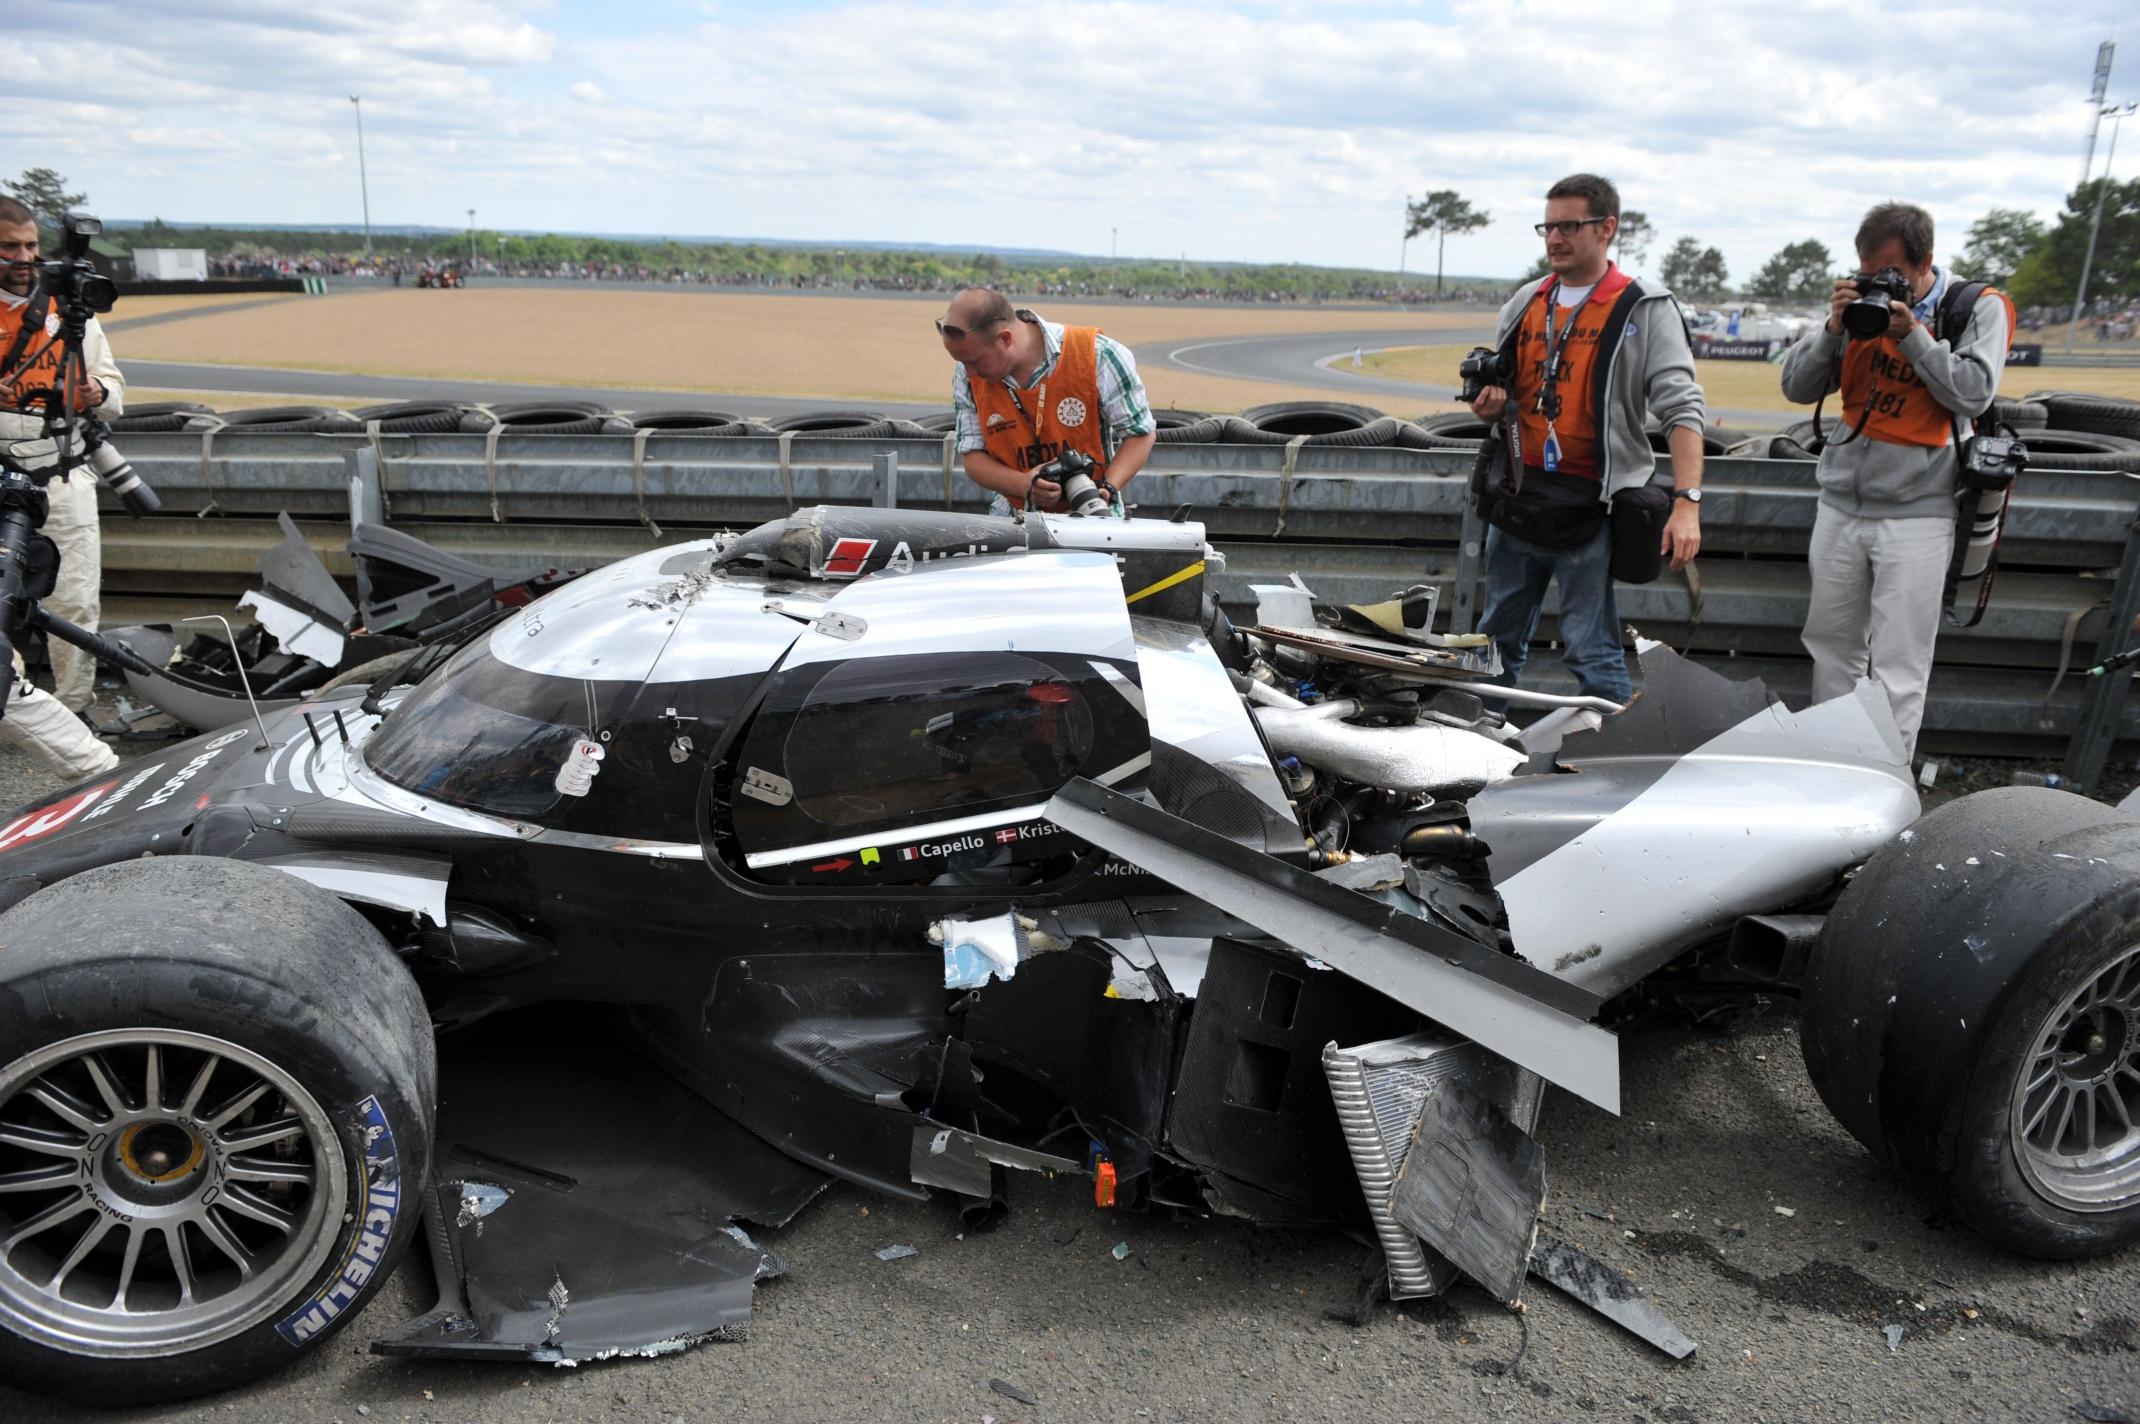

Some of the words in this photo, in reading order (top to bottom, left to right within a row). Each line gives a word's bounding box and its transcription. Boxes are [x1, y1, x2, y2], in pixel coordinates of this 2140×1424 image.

[1710, 346, 1765, 356] PEUGEOT
[1511, 421, 1521, 458] DIGITAL
[136, 748, 224, 812] BOSCH
[920, 836, 985, 858] Capello
[1018, 823, 1066, 839] Krist
[83, 1183, 134, 1223] RACING
[292, 1156, 396, 1341] MICHELIN
